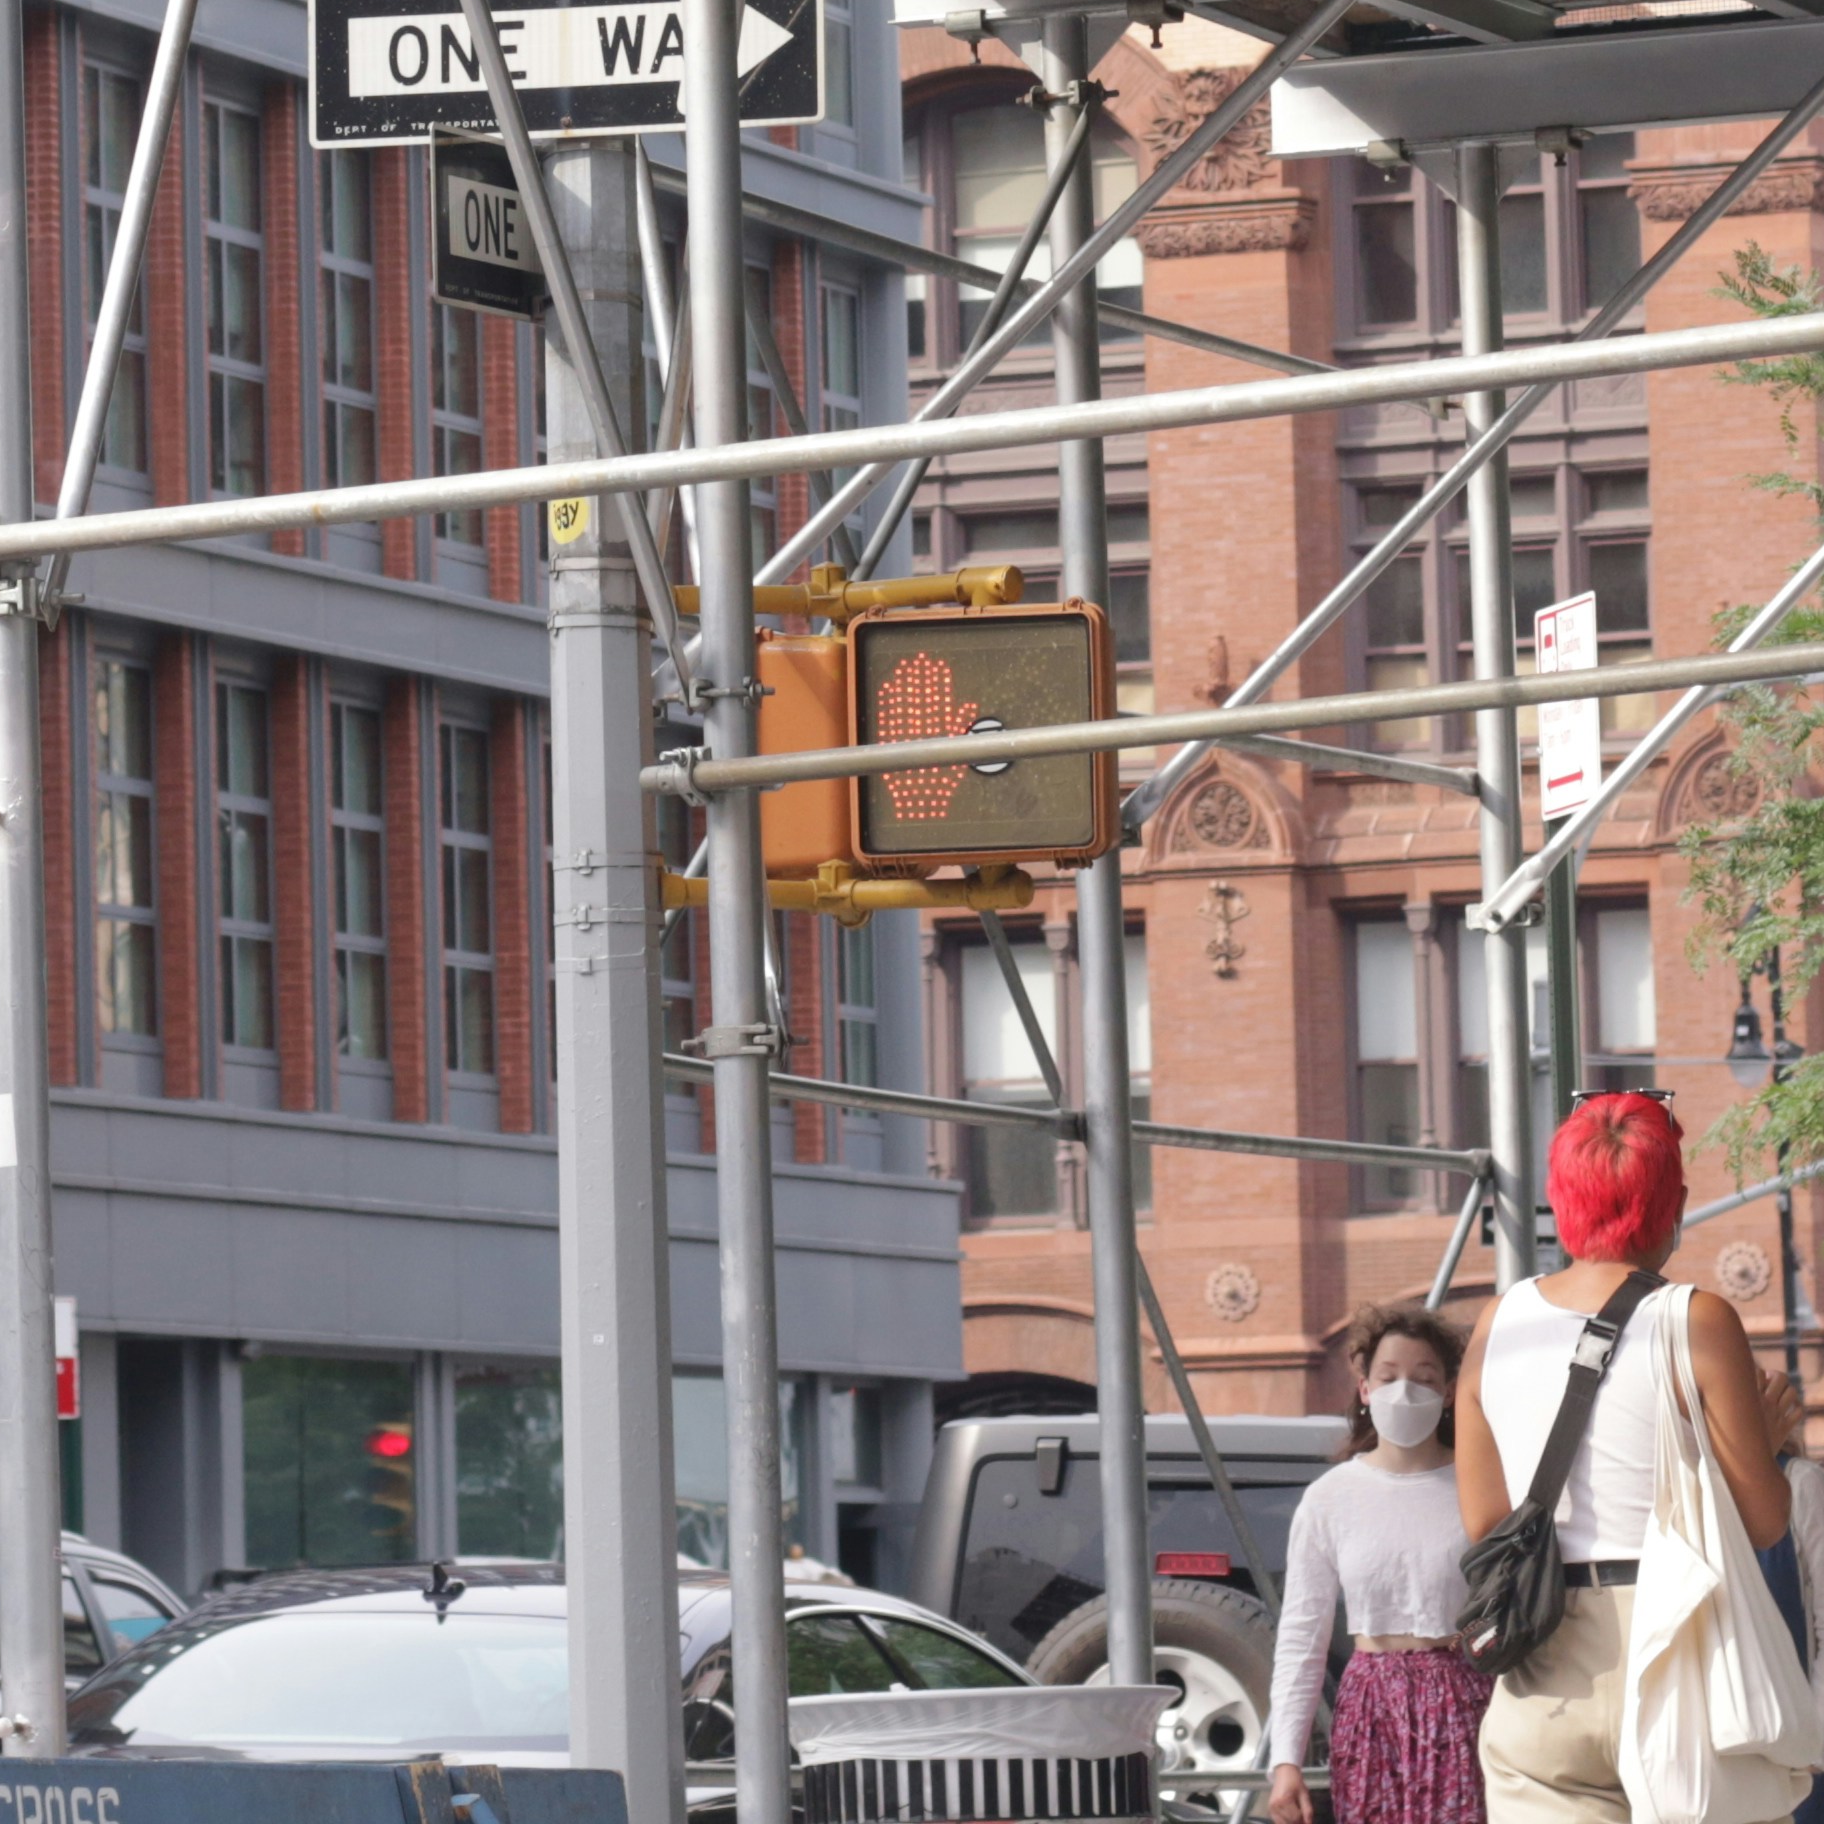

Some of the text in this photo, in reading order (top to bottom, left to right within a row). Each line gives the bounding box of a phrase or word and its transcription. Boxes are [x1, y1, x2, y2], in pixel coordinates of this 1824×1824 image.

[389, 13, 683, 86] ONE WA
[463, 188, 519, 261] ONE
